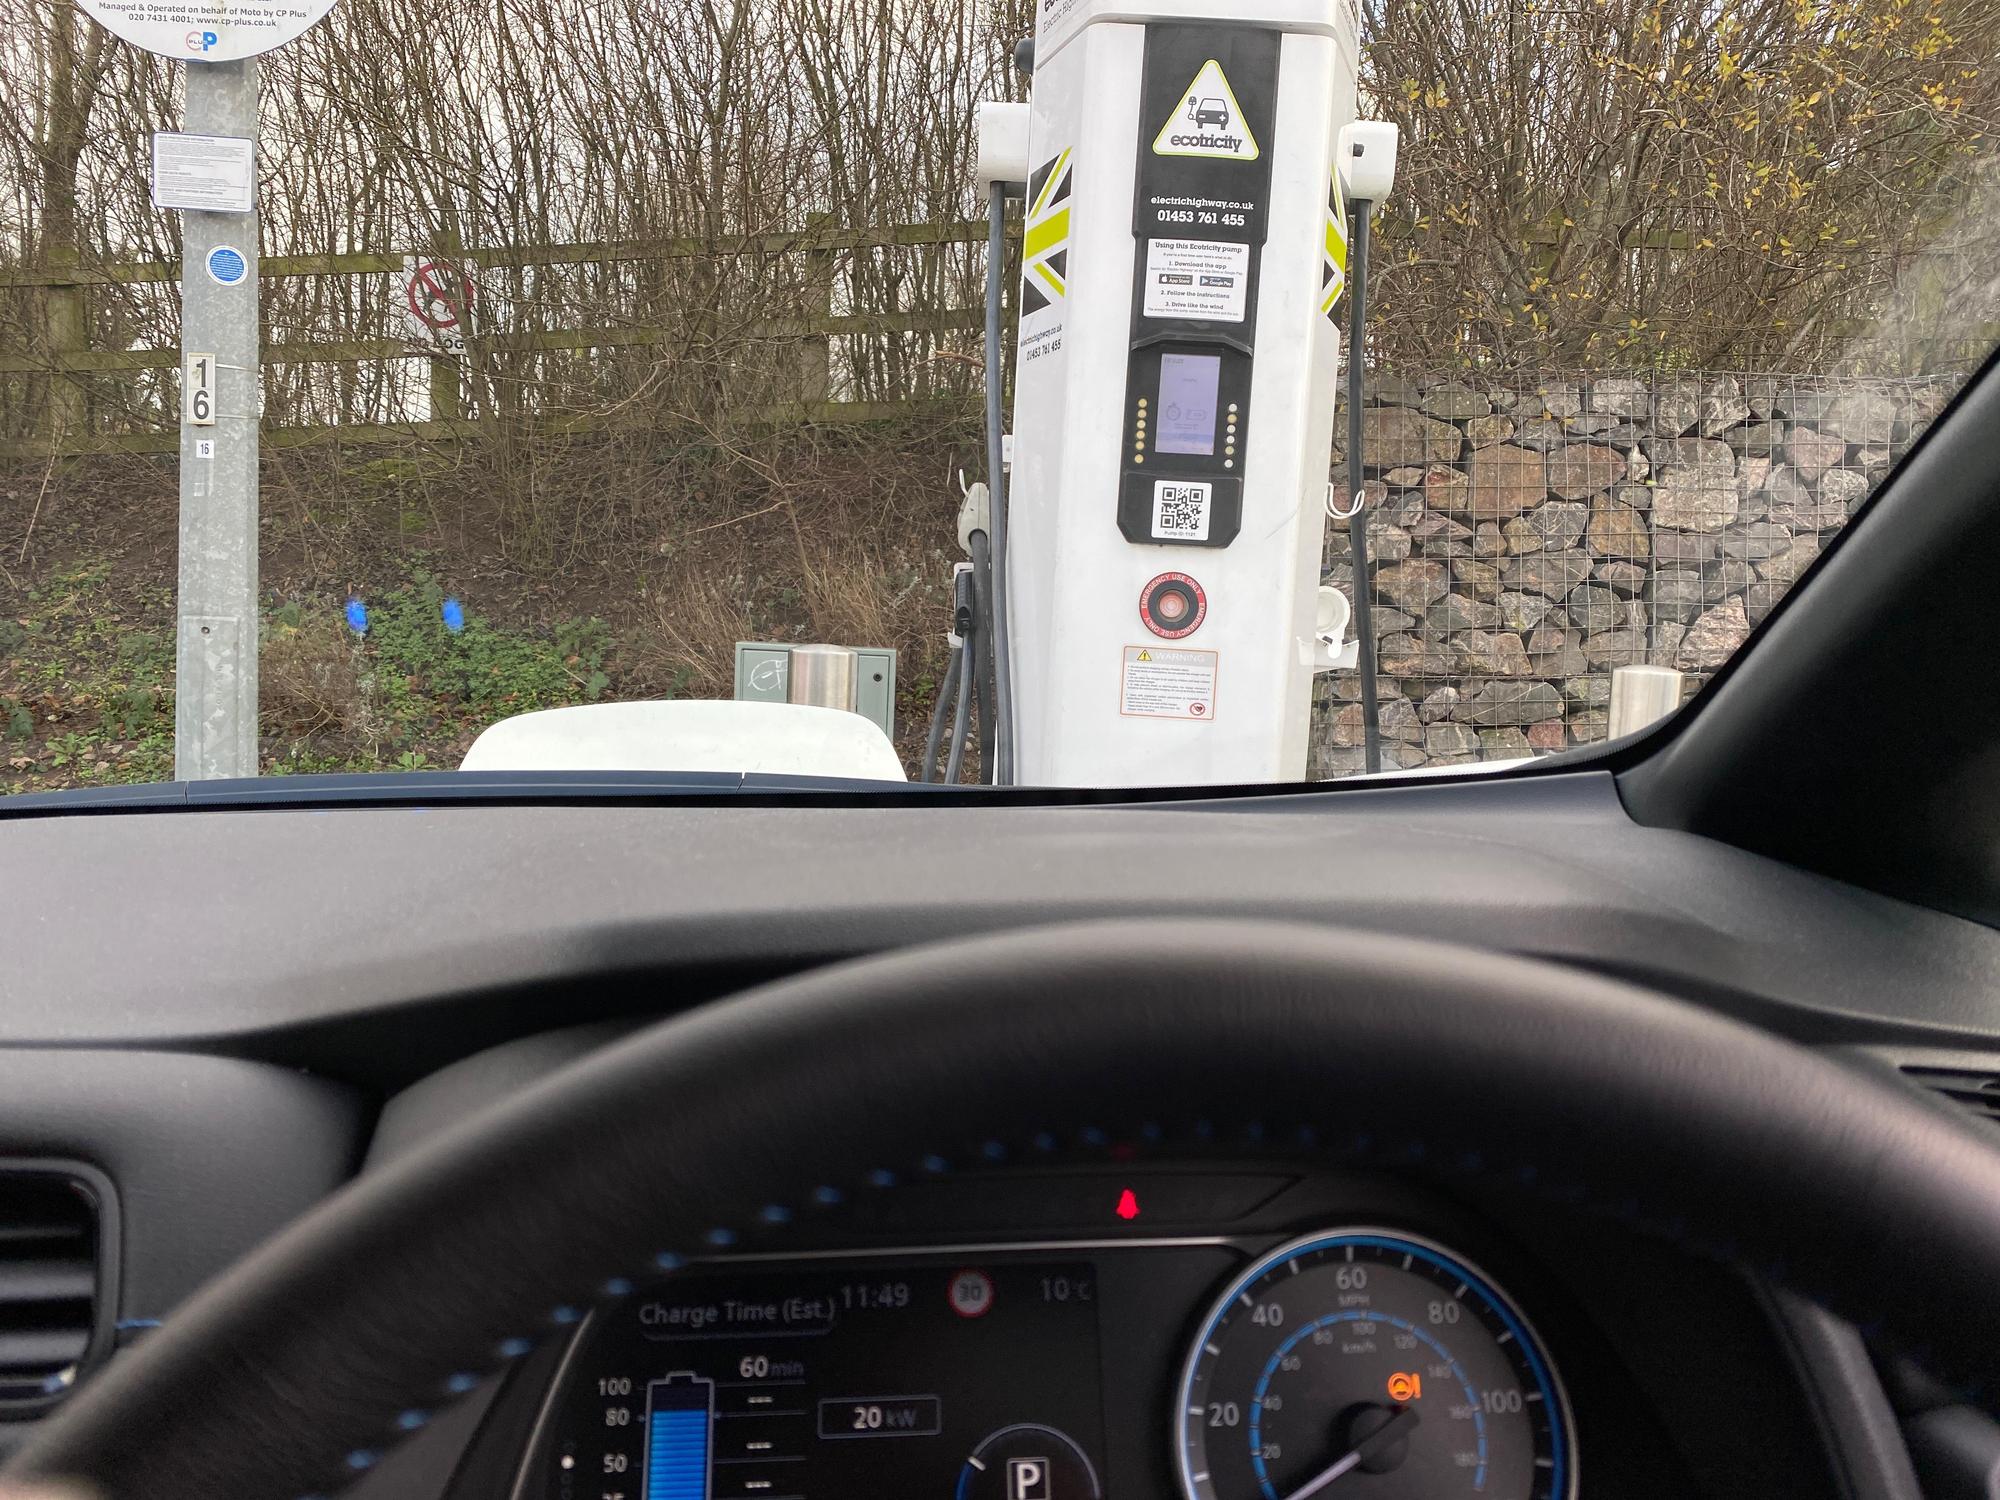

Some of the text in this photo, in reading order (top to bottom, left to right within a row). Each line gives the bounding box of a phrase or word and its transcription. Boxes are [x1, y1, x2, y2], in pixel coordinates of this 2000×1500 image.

[99, 2, 136, 12] Managed
[147, 4, 186, 14] Operated
[201, 6, 227, 15] behalf
[263, 9, 273, 18] by
[289, 10, 307, 18] Plus
[128, 13, 277, 27] 020 7431 4001; www.cp-plus.co.uk
[1170, 134, 1243, 153] ecotricity
[1150, 195, 1255, 210] electrichighway.co.uk
[1157, 209, 1246, 226] 01453 761 455
[1155, 242, 1242, 254] Using this Ecotricity pump
[200, 443, 210, 455] 16
[1141, 574, 1201, 609] EMERGENCY USE ONLY
[1154, 651, 1205, 663] WARNING
[1335, 1265, 1367, 1291] 60
[840, 1281, 910, 1310] 11:49
[638, 1301, 719, 1329] Charge
[722, 1297, 779, 1323] Time
[1251, 1303, 1284, 1328] 40
[1427, 1300, 1461, 1325] 80
[598, 1376, 632, 1397] 100
[1483, 1389, 1522, 1415] 100
[605, 1406, 631, 1428] 80
[851, 1406, 882, 1430] 20
[1208, 1402, 1240, 1428] 20
[602, 1452, 629, 1474] 50
[1261, 1444, 1282, 1460] 20
[1016, 1463, 1041, 1500] P
